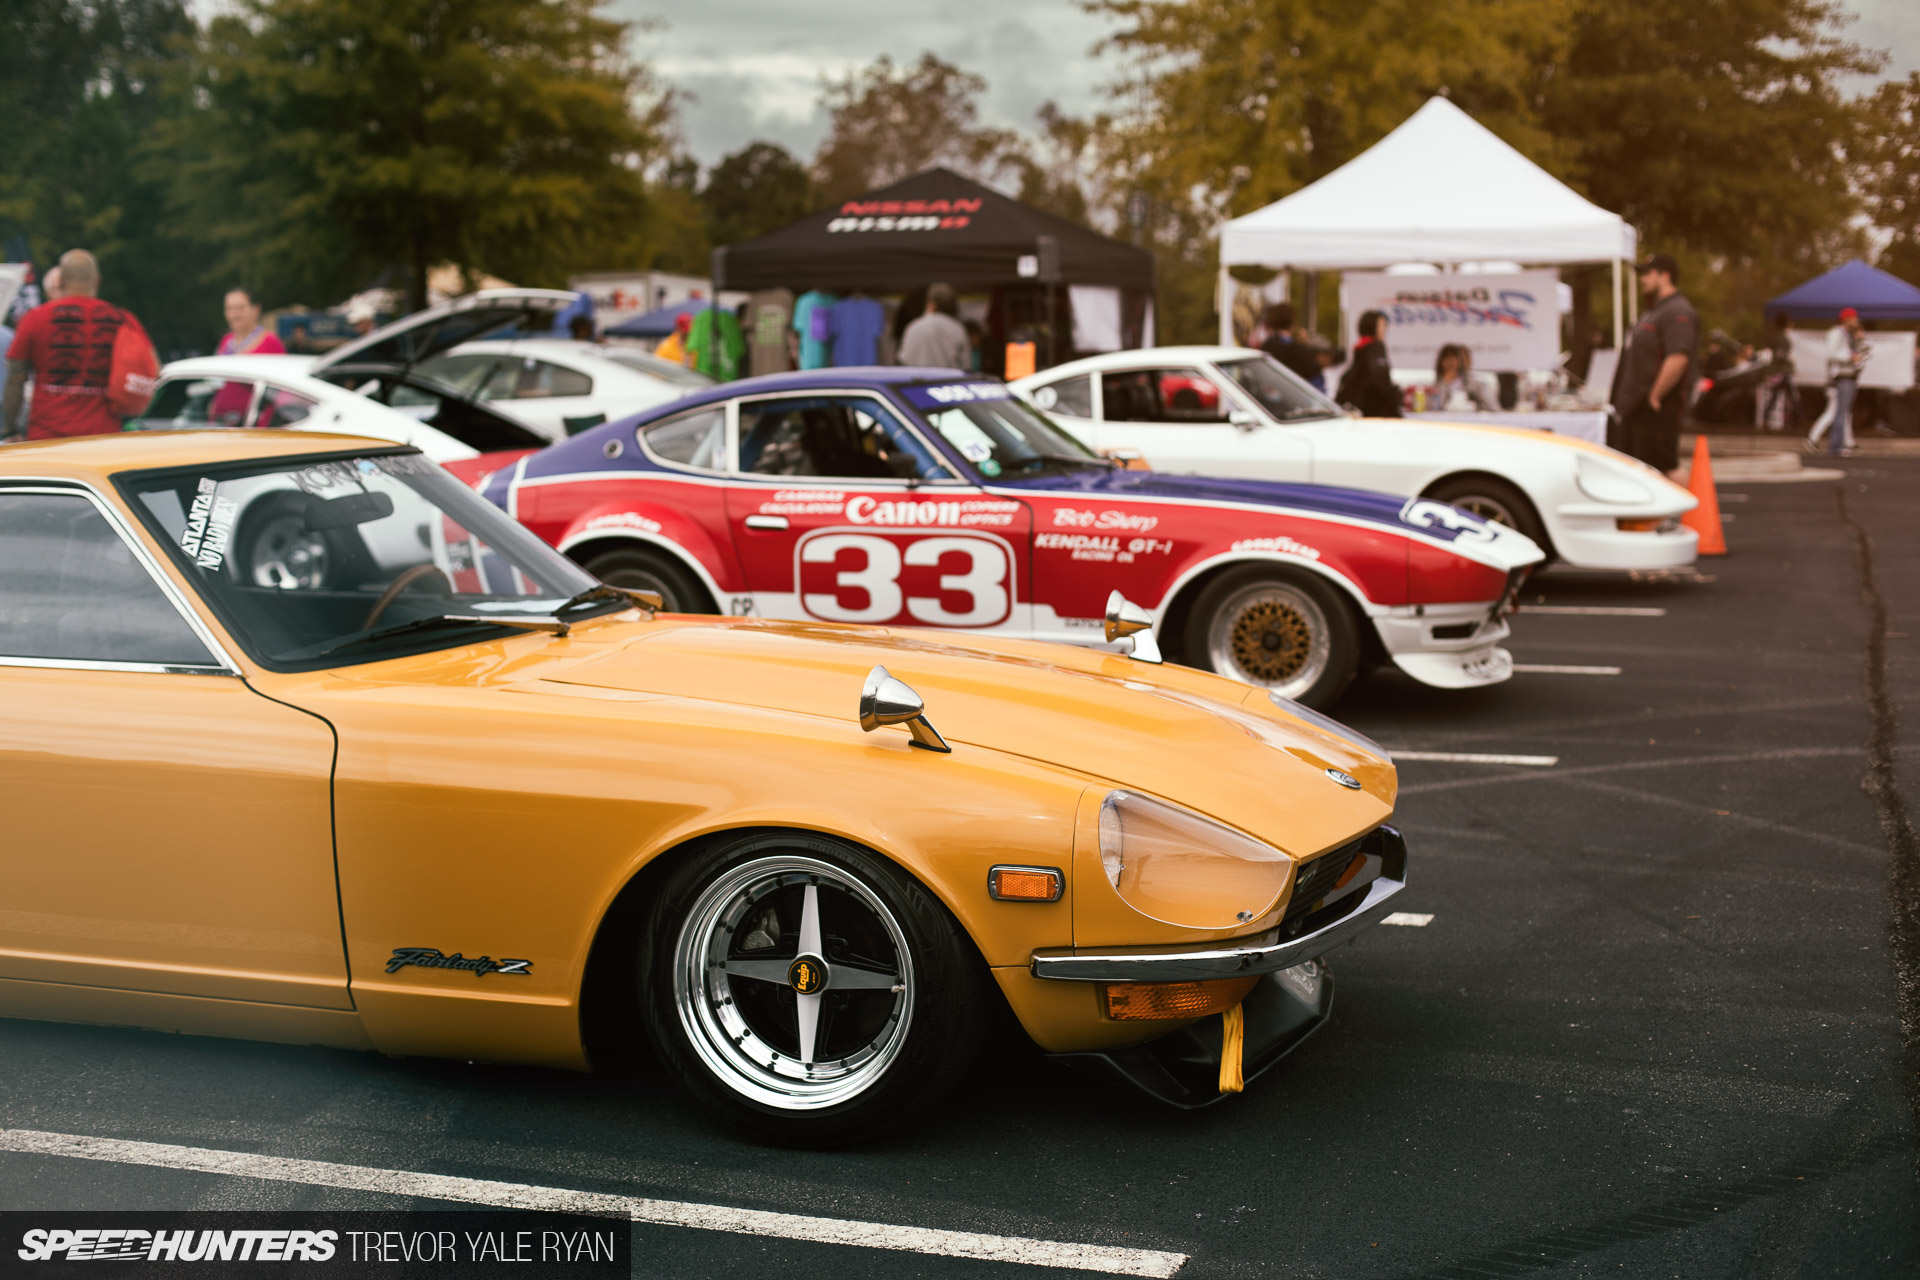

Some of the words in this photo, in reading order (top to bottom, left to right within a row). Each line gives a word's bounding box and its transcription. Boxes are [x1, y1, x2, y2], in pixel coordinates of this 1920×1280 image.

[840, 198, 983, 216] NISSAN
[845, 496, 961, 525] Canon
[1053, 508, 1095, 527] Bob
[1095, 510, 1158, 533] Sharp
[180, 496, 213, 558] ATLANTA
[1035, 533, 1120, 552] KENDALL
[802, 534, 1008, 626] 33
[385, 947, 498, 977] Fairlady
[498, 958, 534, 975] Z
[797, 963, 810, 991] Equip
